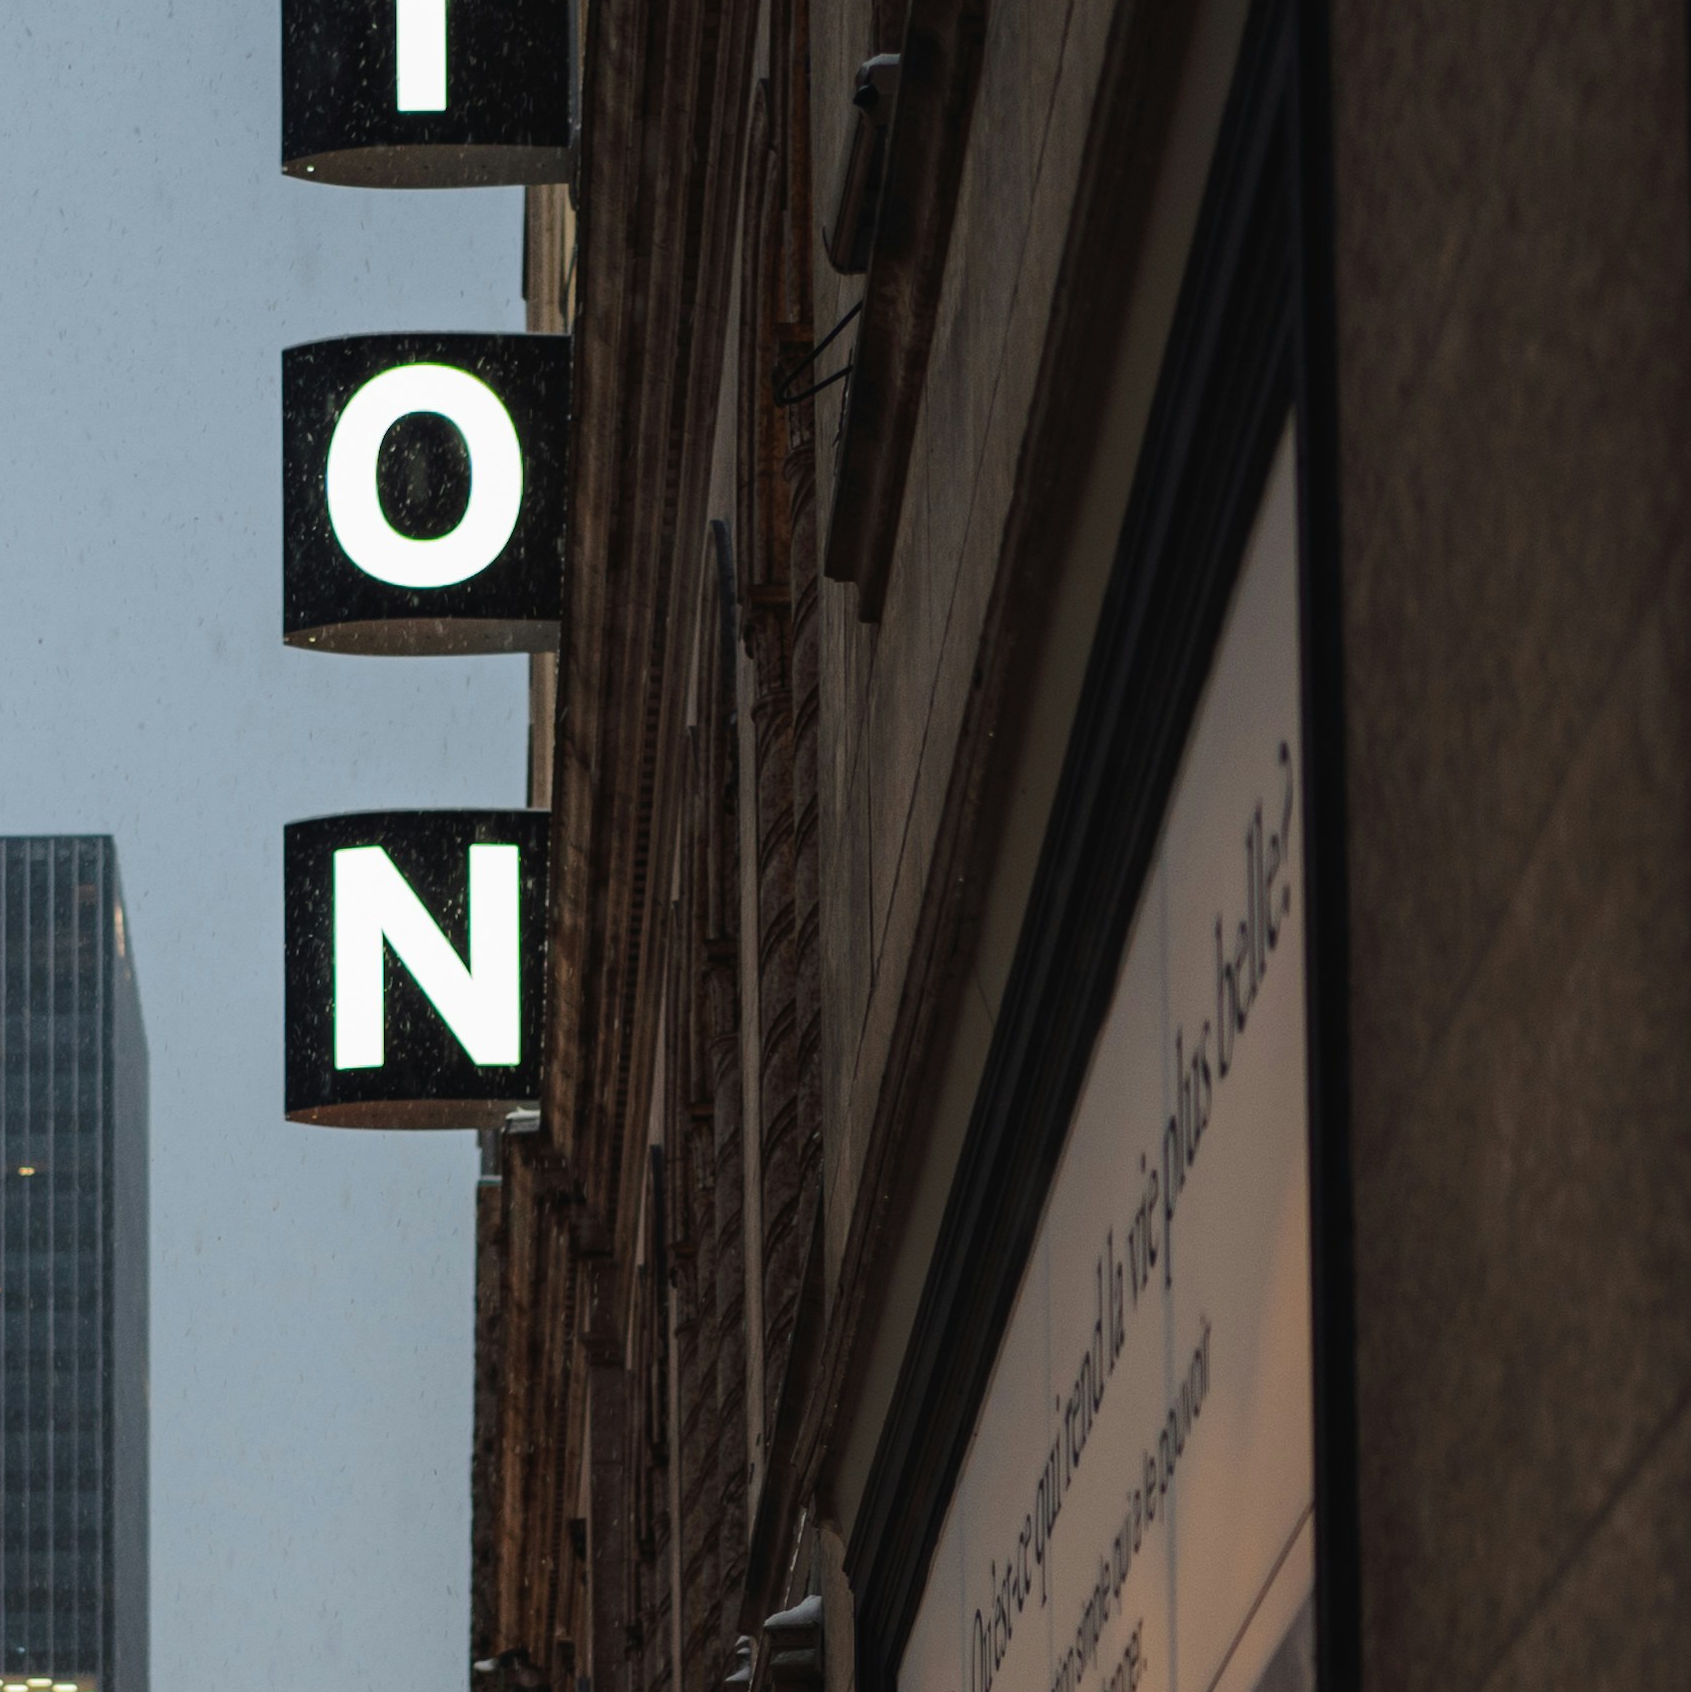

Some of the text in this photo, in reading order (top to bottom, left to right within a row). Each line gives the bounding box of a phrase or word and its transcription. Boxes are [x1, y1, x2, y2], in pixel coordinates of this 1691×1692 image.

[1036, 1393, 1061, 1607] qui
[1065, 1251, 1104, 1491] rend
[1107, 1221, 1125, 1376] la
[1129, 1152, 1159, 1309] vie
[1164, 1019, 1212, 1290] plus
[1215, 740, 1293, 1079] belle?
[1076, 1553, 1110, 1684] simple
[1113, 1493, 1131, 1615] qui
[1133, 1489, 1141, 1553] a
[1143, 1446, 1156, 1529] le
[1159, 1314, 1210, 1524] pouvoir
